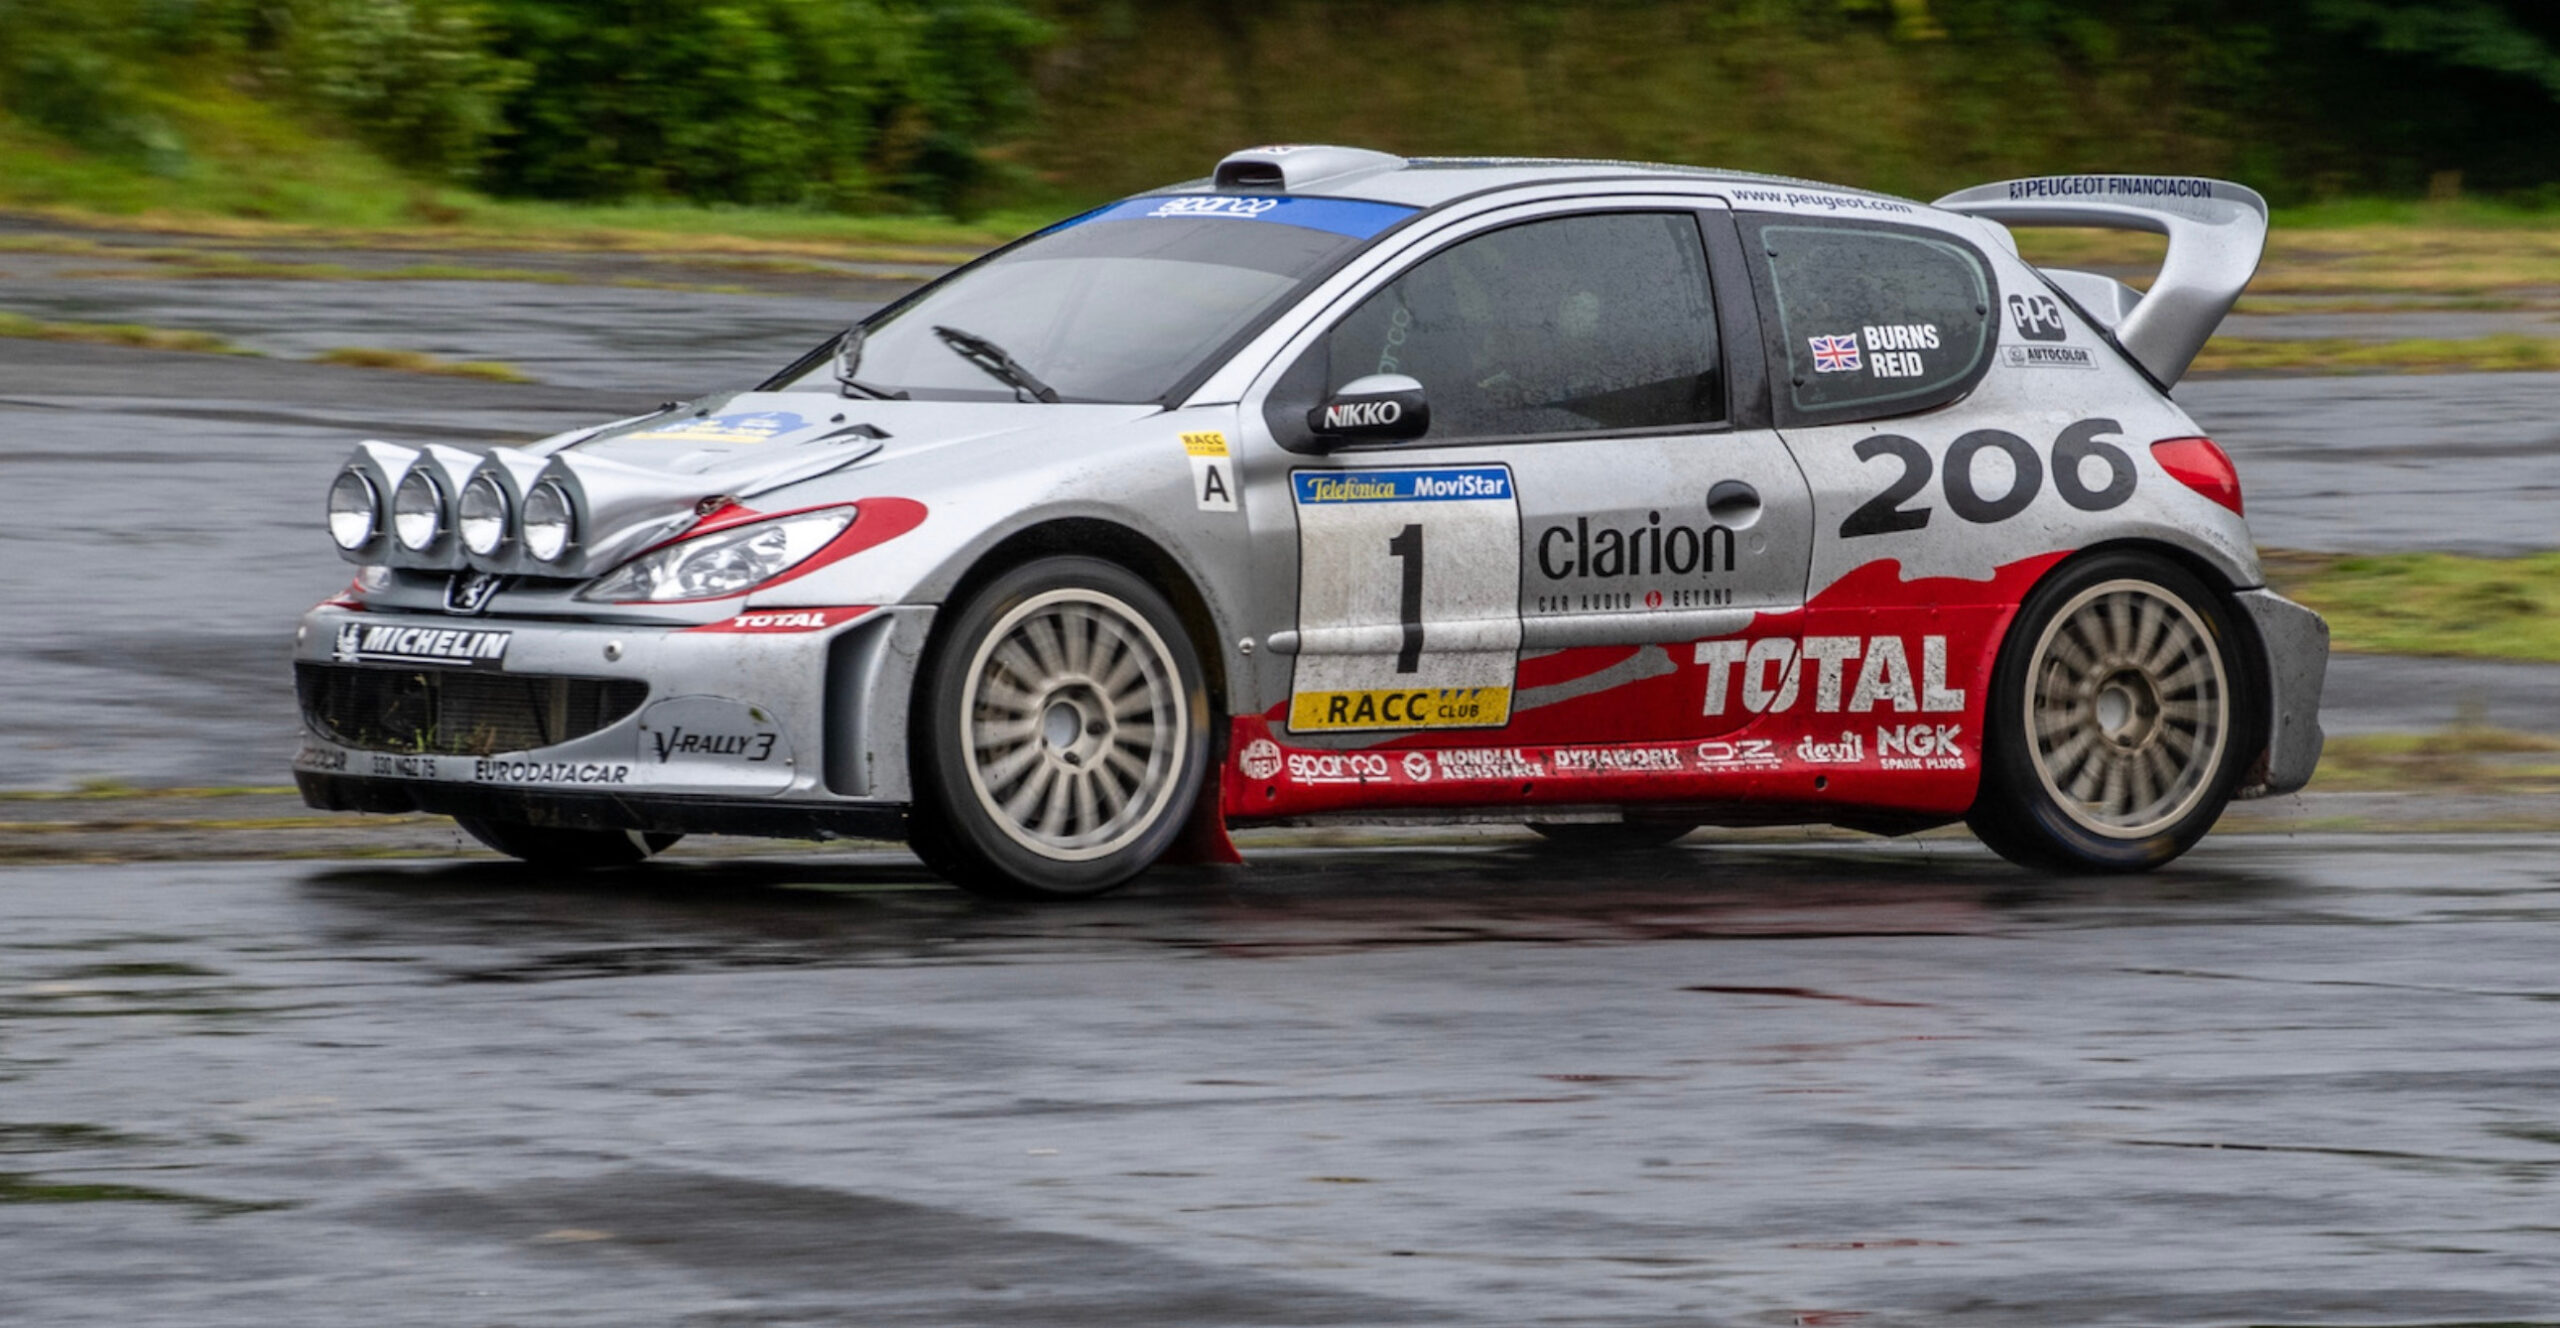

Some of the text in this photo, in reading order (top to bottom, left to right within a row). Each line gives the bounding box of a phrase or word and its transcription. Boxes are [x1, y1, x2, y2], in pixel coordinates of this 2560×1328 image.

[1731, 189, 1913, 214] www.peugeot.com
[2026, 177, 2212, 198] PEUGEOT FINANCIACION
[2010, 295, 2063, 334] PPG
[1863, 324, 1941, 351] BURNS
[1870, 353, 1924, 378] REID
[2027, 347, 2089, 361] AUTOCOLOR
[1324, 401, 1401, 429] NIKKO
[1182, 434, 1223, 445] RACC
[1203, 465, 1231, 502] A
[1414, 475, 1505, 497] MoviStar
[1839, 417, 2138, 538] 206
[1538, 510, 1735, 580] clarion
[1389, 524, 1424, 673] 1
[1539, 595, 1569, 613] CAR
[1581, 592, 1632, 611] AUDIO
[1673, 588, 1732, 607] BEYOND
[734, 612, 827, 628] TOTAL
[361, 626, 511, 658] MICHELIN
[1694, 635, 1966, 716] TOTAL
[1327, 693, 1480, 723] RACC CLUB
[1796, 730, 1865, 762] devil
[1876, 723, 1963, 757] NGK
[475, 760, 629, 783] EURODATACAR
[1288, 754, 1389, 785] sparco
[1880, 758, 1967, 770] SPARK PLUGS
